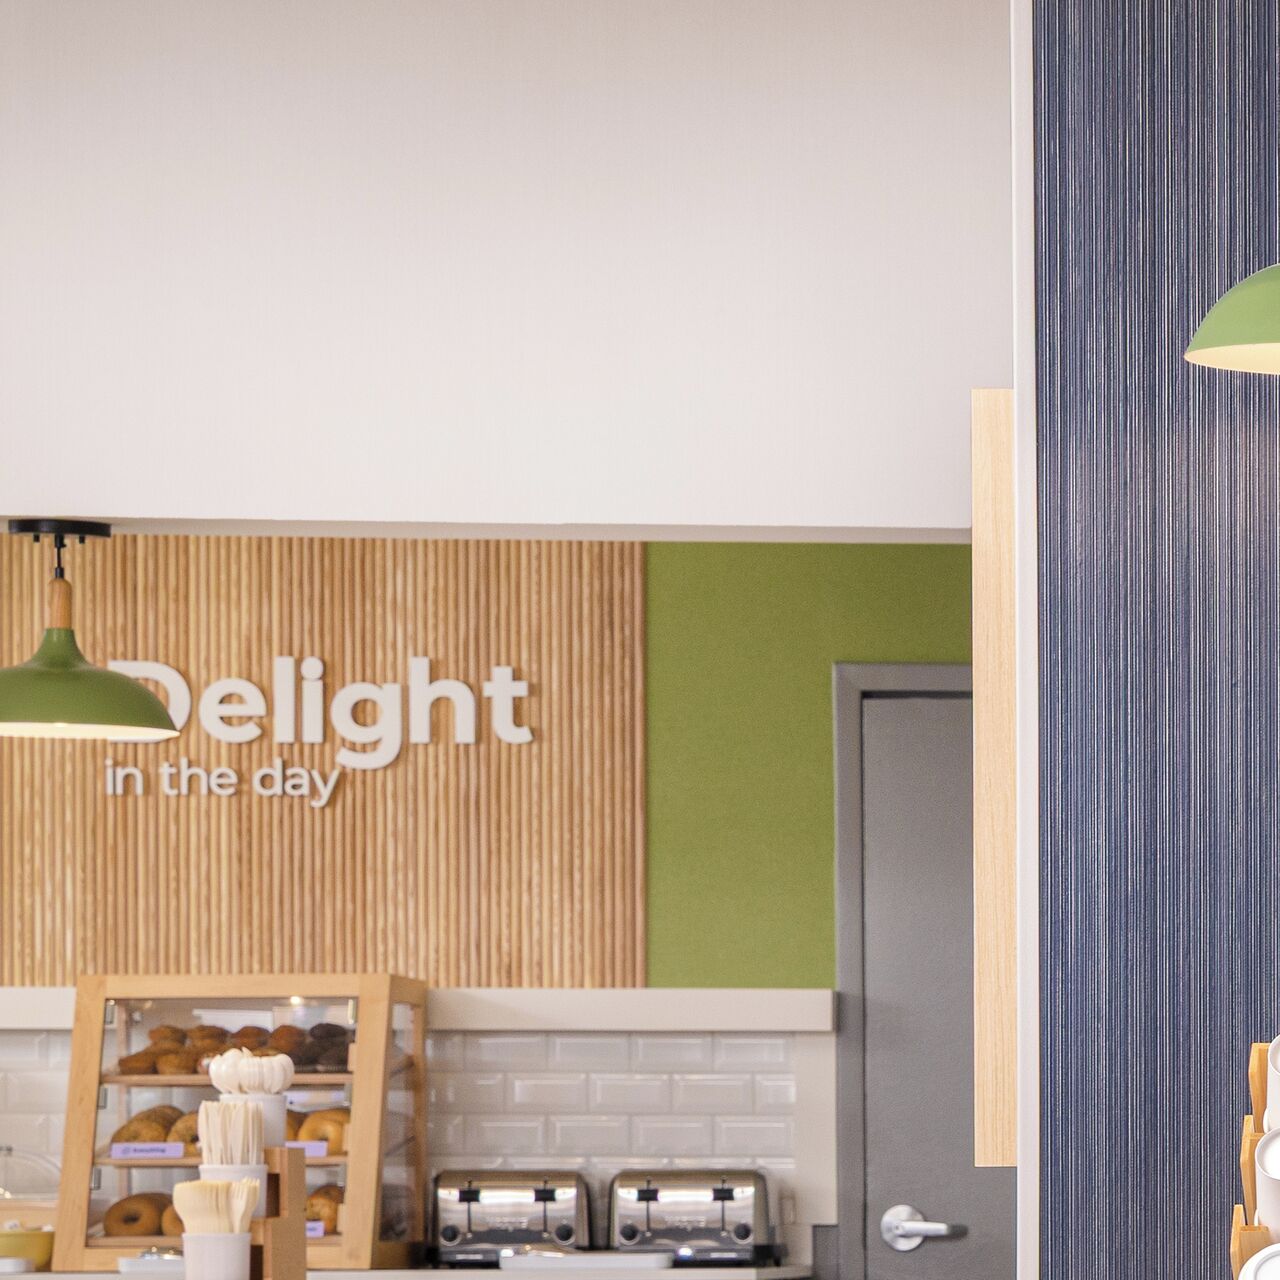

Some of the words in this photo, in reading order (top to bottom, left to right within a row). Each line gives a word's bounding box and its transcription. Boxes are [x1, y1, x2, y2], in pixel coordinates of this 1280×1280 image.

[105, 758, 143, 796] in
[159, 758, 238, 796] the
[252, 757, 340, 808] day
